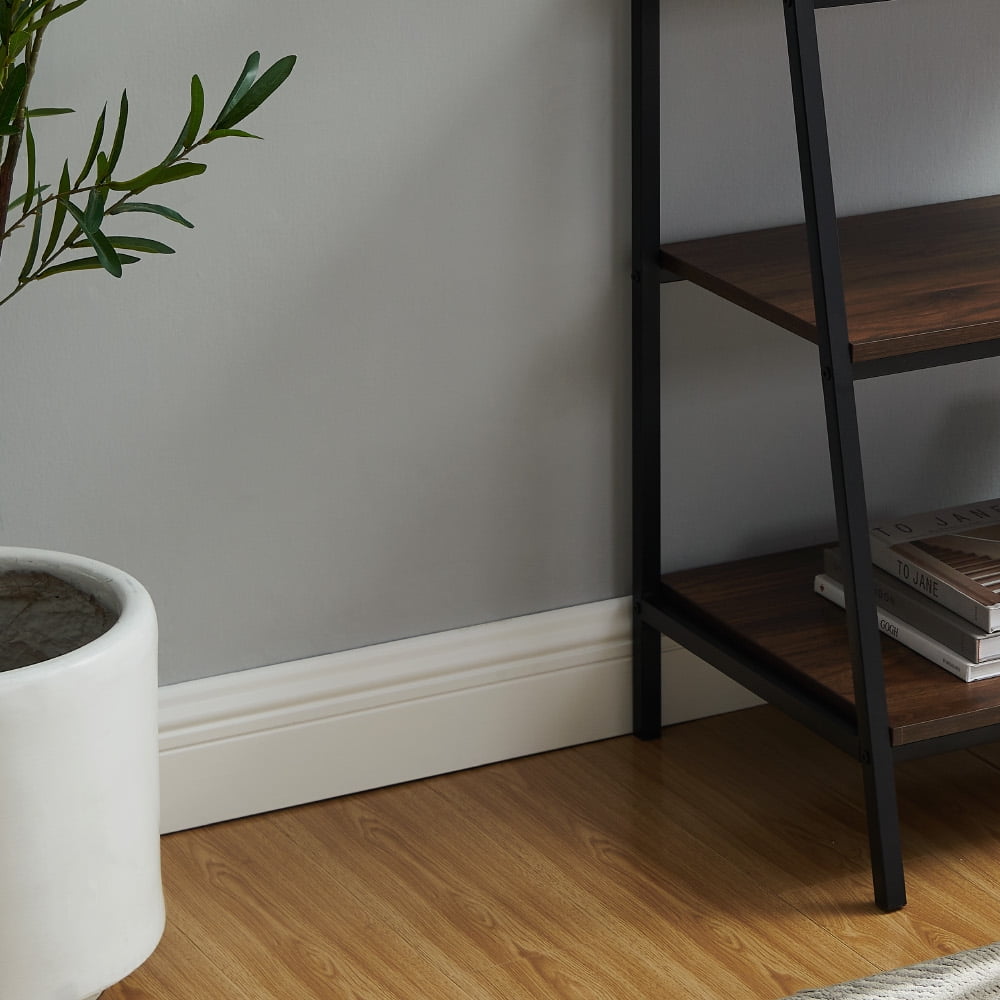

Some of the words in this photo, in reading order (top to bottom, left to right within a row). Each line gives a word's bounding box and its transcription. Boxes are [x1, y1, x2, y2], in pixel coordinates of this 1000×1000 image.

[871, 522, 913, 537] TO
[896, 559, 910, 579] TO
[912, 574, 939, 598] JANE
[880, 619, 899, 638] GOGH
